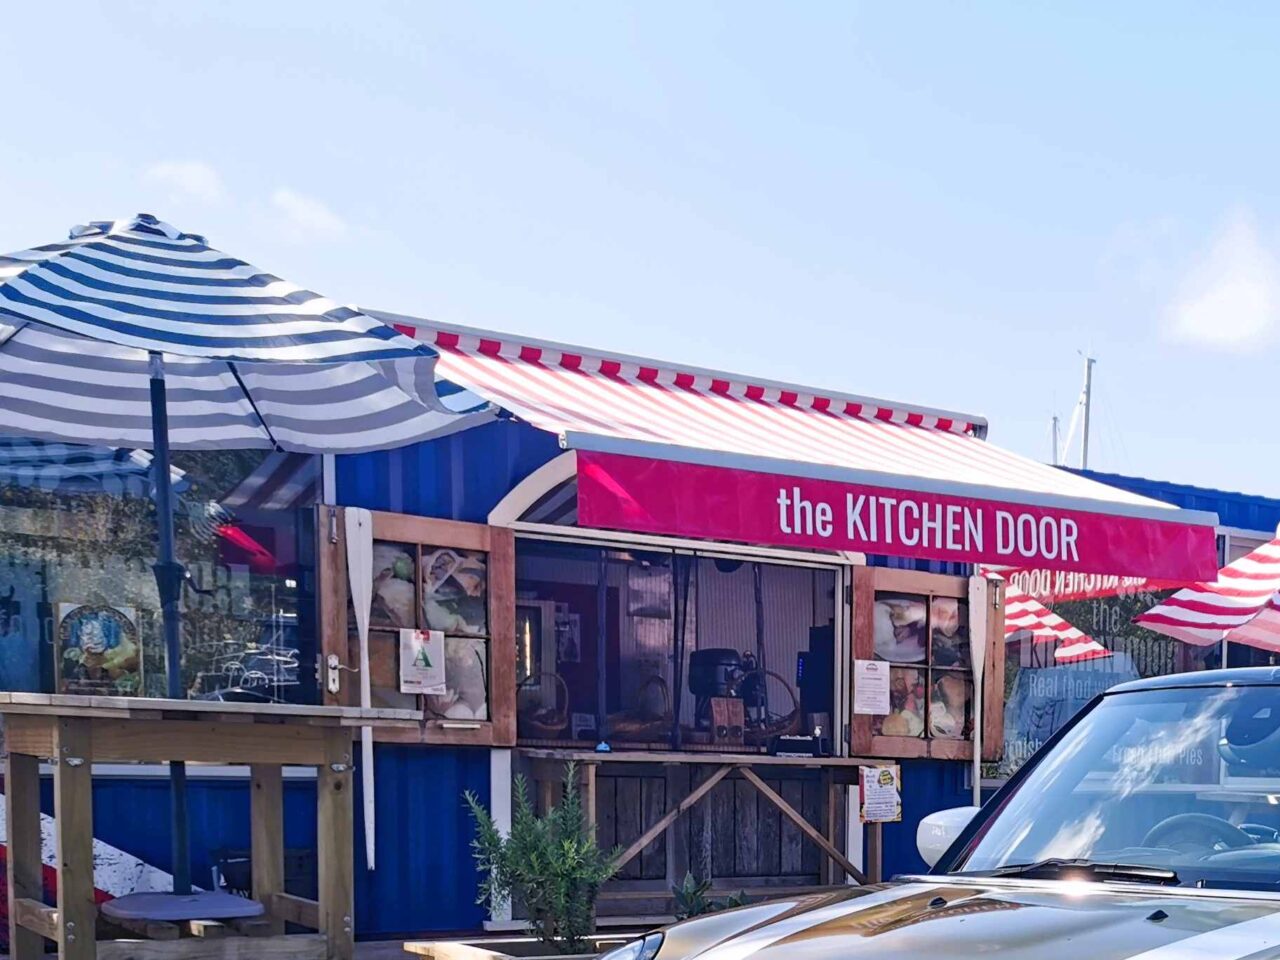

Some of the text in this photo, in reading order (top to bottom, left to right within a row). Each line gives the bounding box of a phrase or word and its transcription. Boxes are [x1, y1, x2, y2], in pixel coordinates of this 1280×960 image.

[776, 486, 1080, 563] the KITCHEN DOOR
[1091, 600, 1121, 633] the
[412, 646, 433, 667] A
[1029, 673, 1059, 699] Real
[1062, 675, 1092, 700] food
[1178, 747, 1204, 767] Pies
